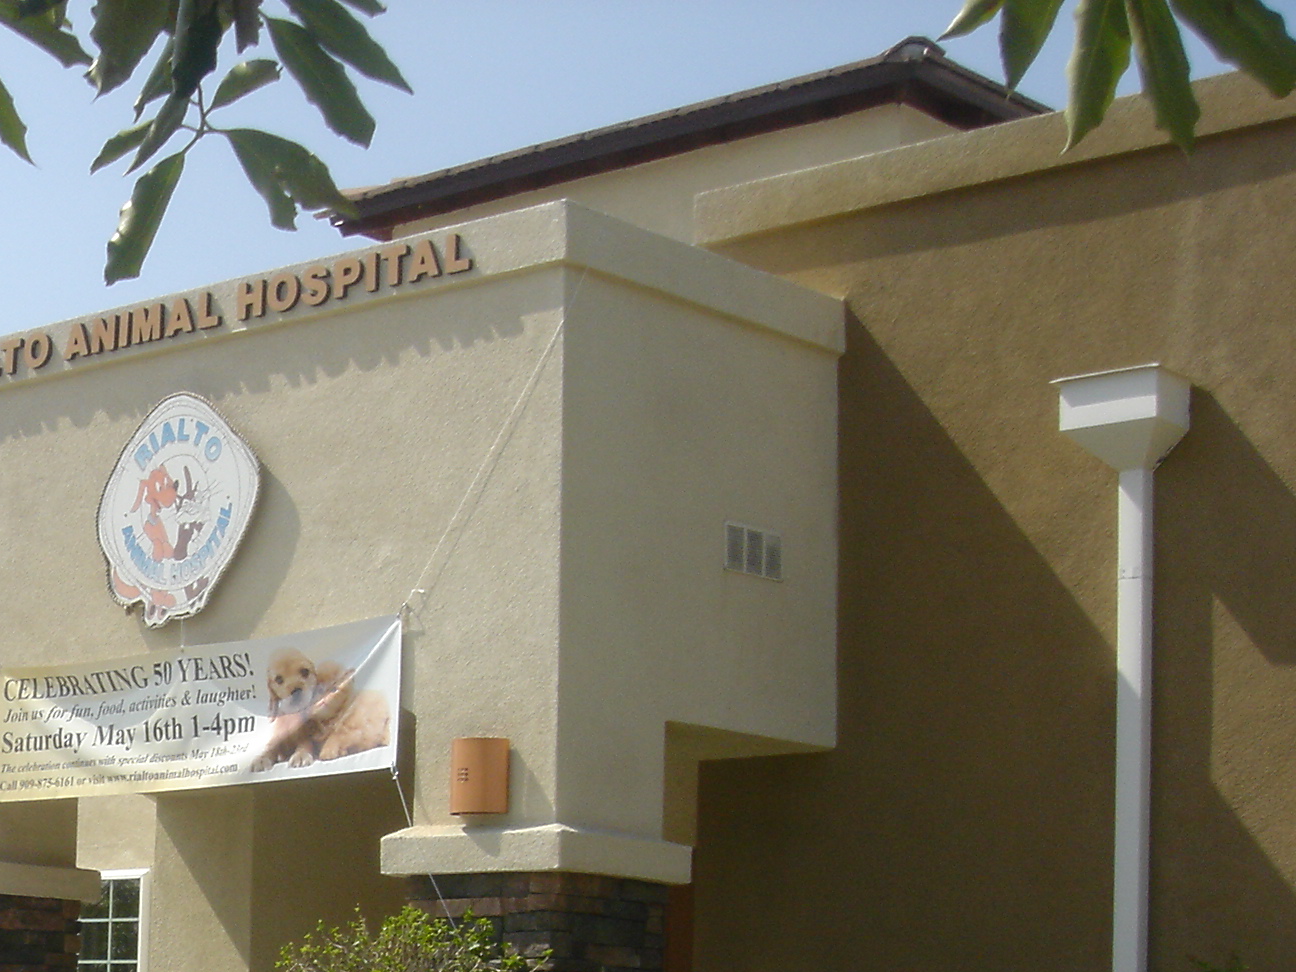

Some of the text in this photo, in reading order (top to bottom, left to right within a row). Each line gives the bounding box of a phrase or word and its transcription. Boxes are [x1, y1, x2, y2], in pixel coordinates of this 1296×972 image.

[63, 298, 222, 361] ANIMAL
[236, 233, 473, 321] HOSPITAL
[133, 418, 222, 471] RIALTO
[121, 502, 232, 585] ANIMAL HOSPITAL
[4, 652, 254, 701] CELEBRATING 50 YEARS!
[3, 708, 28, 723] Join
[31, 709, 43, 718] us
[44, 706, 68, 723] for
[95, 699, 125, 720] food,
[129, 693, 176, 711] activities
[181, 690, 191, 706] &
[196, 685, 256, 706] laughter!
[1, 712, 255, 754] Saturday May 16th 1-4pm
[0, 780, 17, 791] Call
[76, 778, 87, 786] or
[88, 773, 105, 785] visit
[107, 762, 238, 782] www.rialtoanimalhospital.com
[1, 764, 15, 774] The
[16, 761, 61, 773] celebration
[98, 755, 115, 766] with
[118, 754, 149, 767] special
[150, 752, 188, 763] discounts
[191, 748, 209, 760] May
